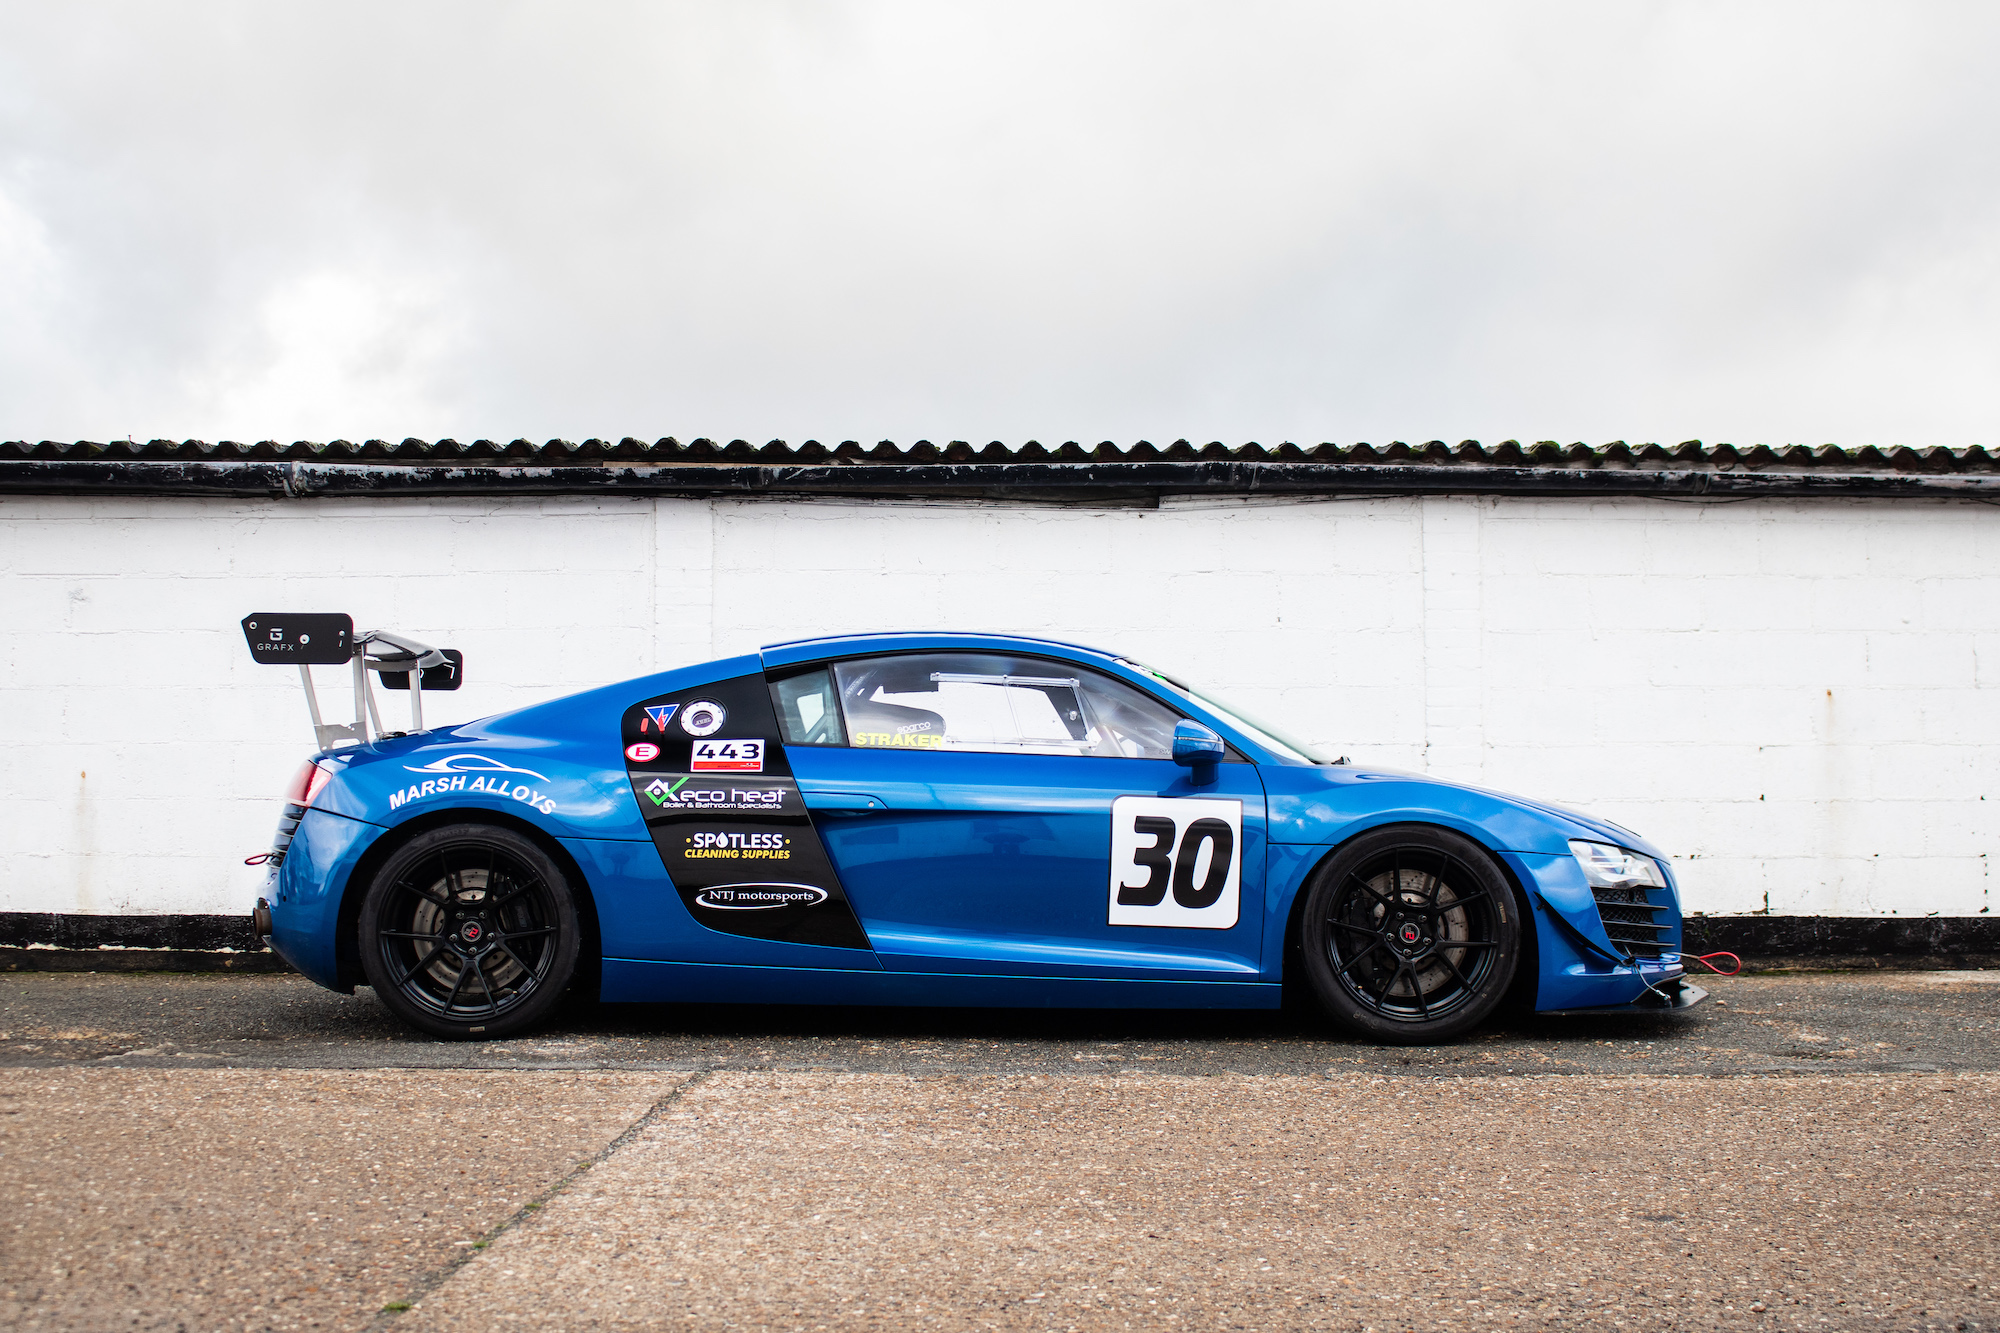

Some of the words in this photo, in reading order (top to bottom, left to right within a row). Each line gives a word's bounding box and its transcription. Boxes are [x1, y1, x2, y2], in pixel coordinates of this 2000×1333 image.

[257, 643, 294, 651] GRAFX
[897, 721, 931, 734] sparco
[855, 732, 943, 748] STRAKER
[635, 747, 651, 757] E
[697, 743, 760, 759] 443
[389, 775, 467, 810] MARSH
[469, 776, 557, 815] ALLOYS
[680, 790, 726, 802] eco
[731, 788, 786, 803] heat
[737, 802, 782, 810] Specialists
[693, 832, 783, 849] SPOTLESS
[684, 849, 739, 859] CLEANING
[741, 850, 790, 860] SUPPLIES
[1117, 815, 1234, 909] 30
[709, 890, 734, 902] NTJ
[737, 890, 814, 902] motorsports
